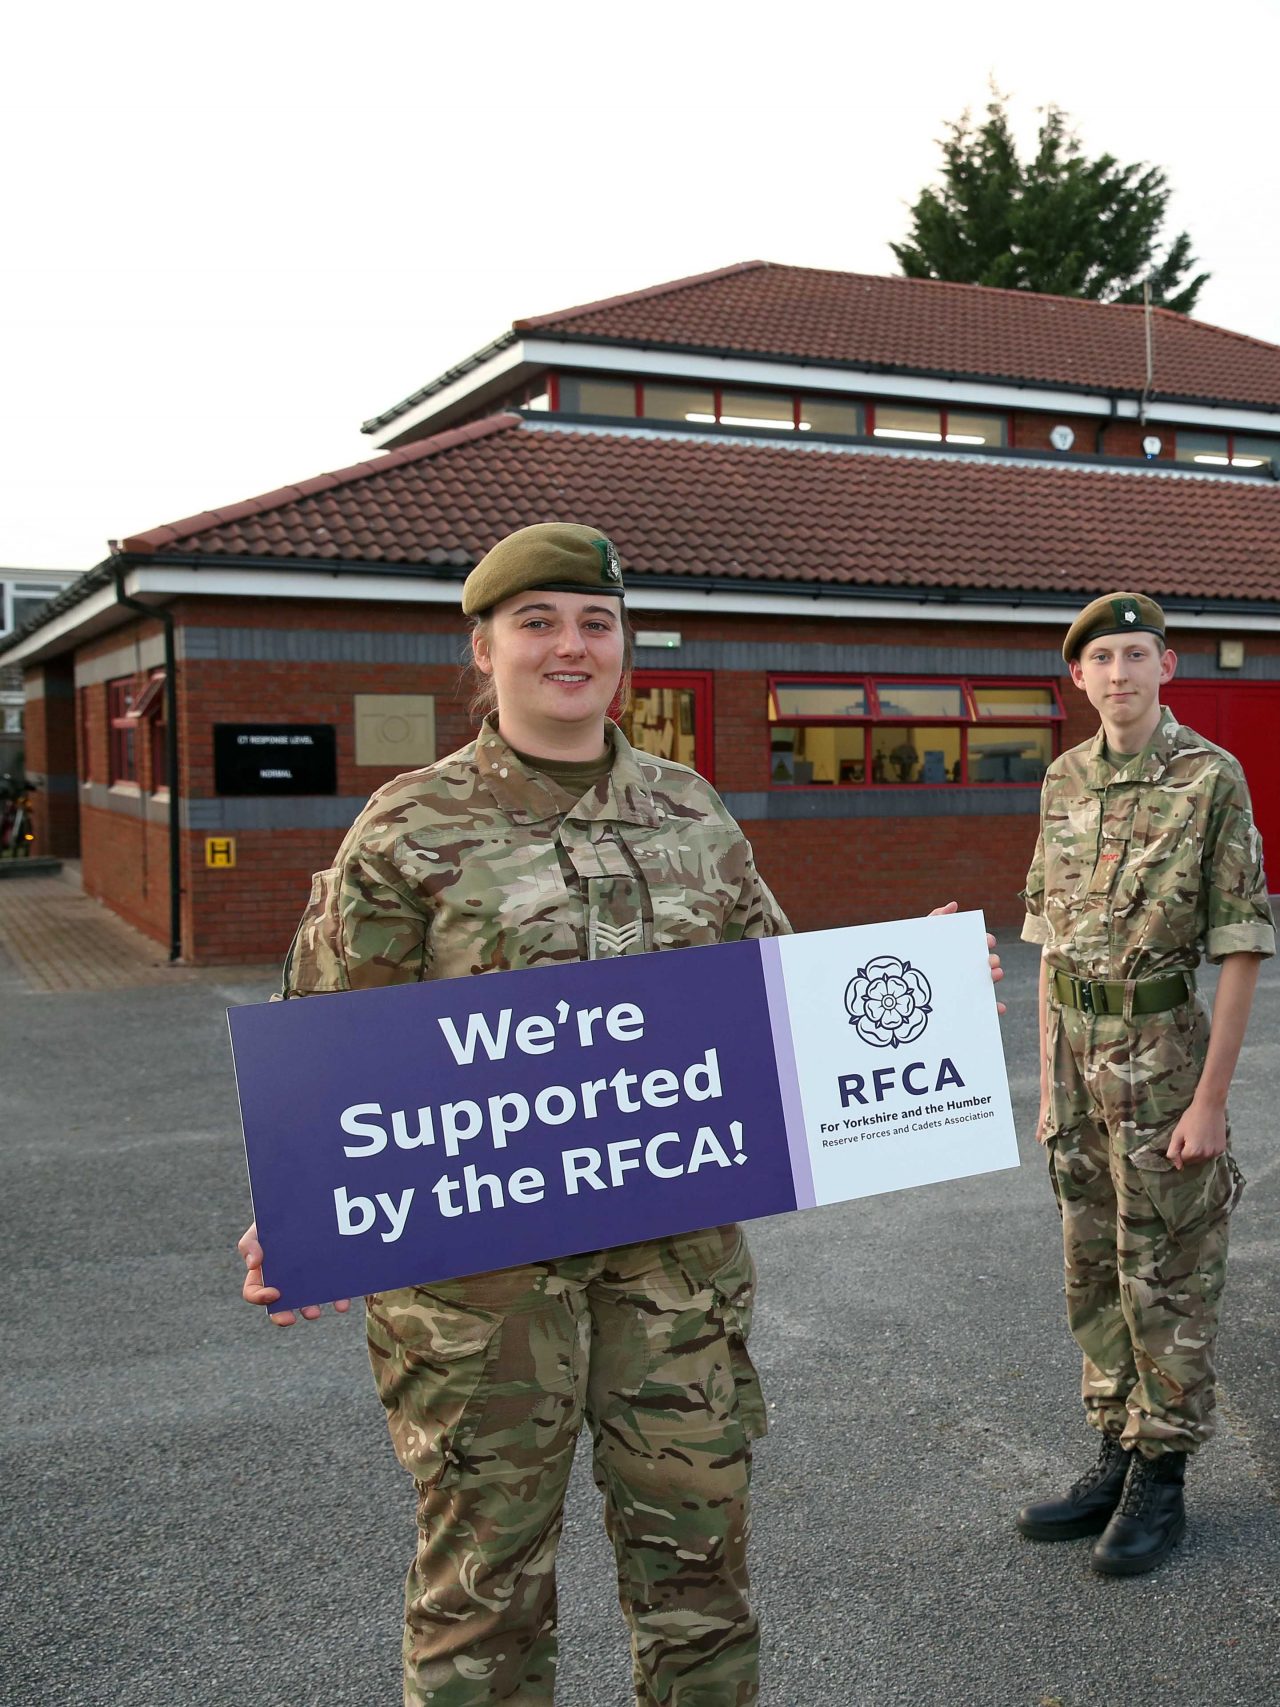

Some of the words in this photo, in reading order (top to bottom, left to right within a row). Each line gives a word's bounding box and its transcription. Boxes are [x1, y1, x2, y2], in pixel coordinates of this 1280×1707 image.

[249, 735, 288, 745] RESPONSE
[289, 735, 314, 745] LEVEL
[260, 769, 293, 779] NORMAL
[211, 840, 231, 865] H
[837, 1057, 966, 1108] RFCA
[339, 1048, 724, 1158] Supported
[820, 1123, 840, 1133] For
[843, 1112, 898, 1129] Yorkshire
[901, 1106, 922, 1119] and
[925, 1103, 944, 1115] the
[946, 1095, 992, 1111] Humber
[822, 1136, 858, 1148] Reserve
[860, 1130, 891, 1141] Forces
[893, 1124, 910, 1136] and
[911, 1119, 942, 1132] Cadets
[944, 1110, 995, 1125] Association
[333, 1185, 416, 1244] by
[431, 1163, 546, 1219] the
[561, 1120, 749, 1196] RFCA!
